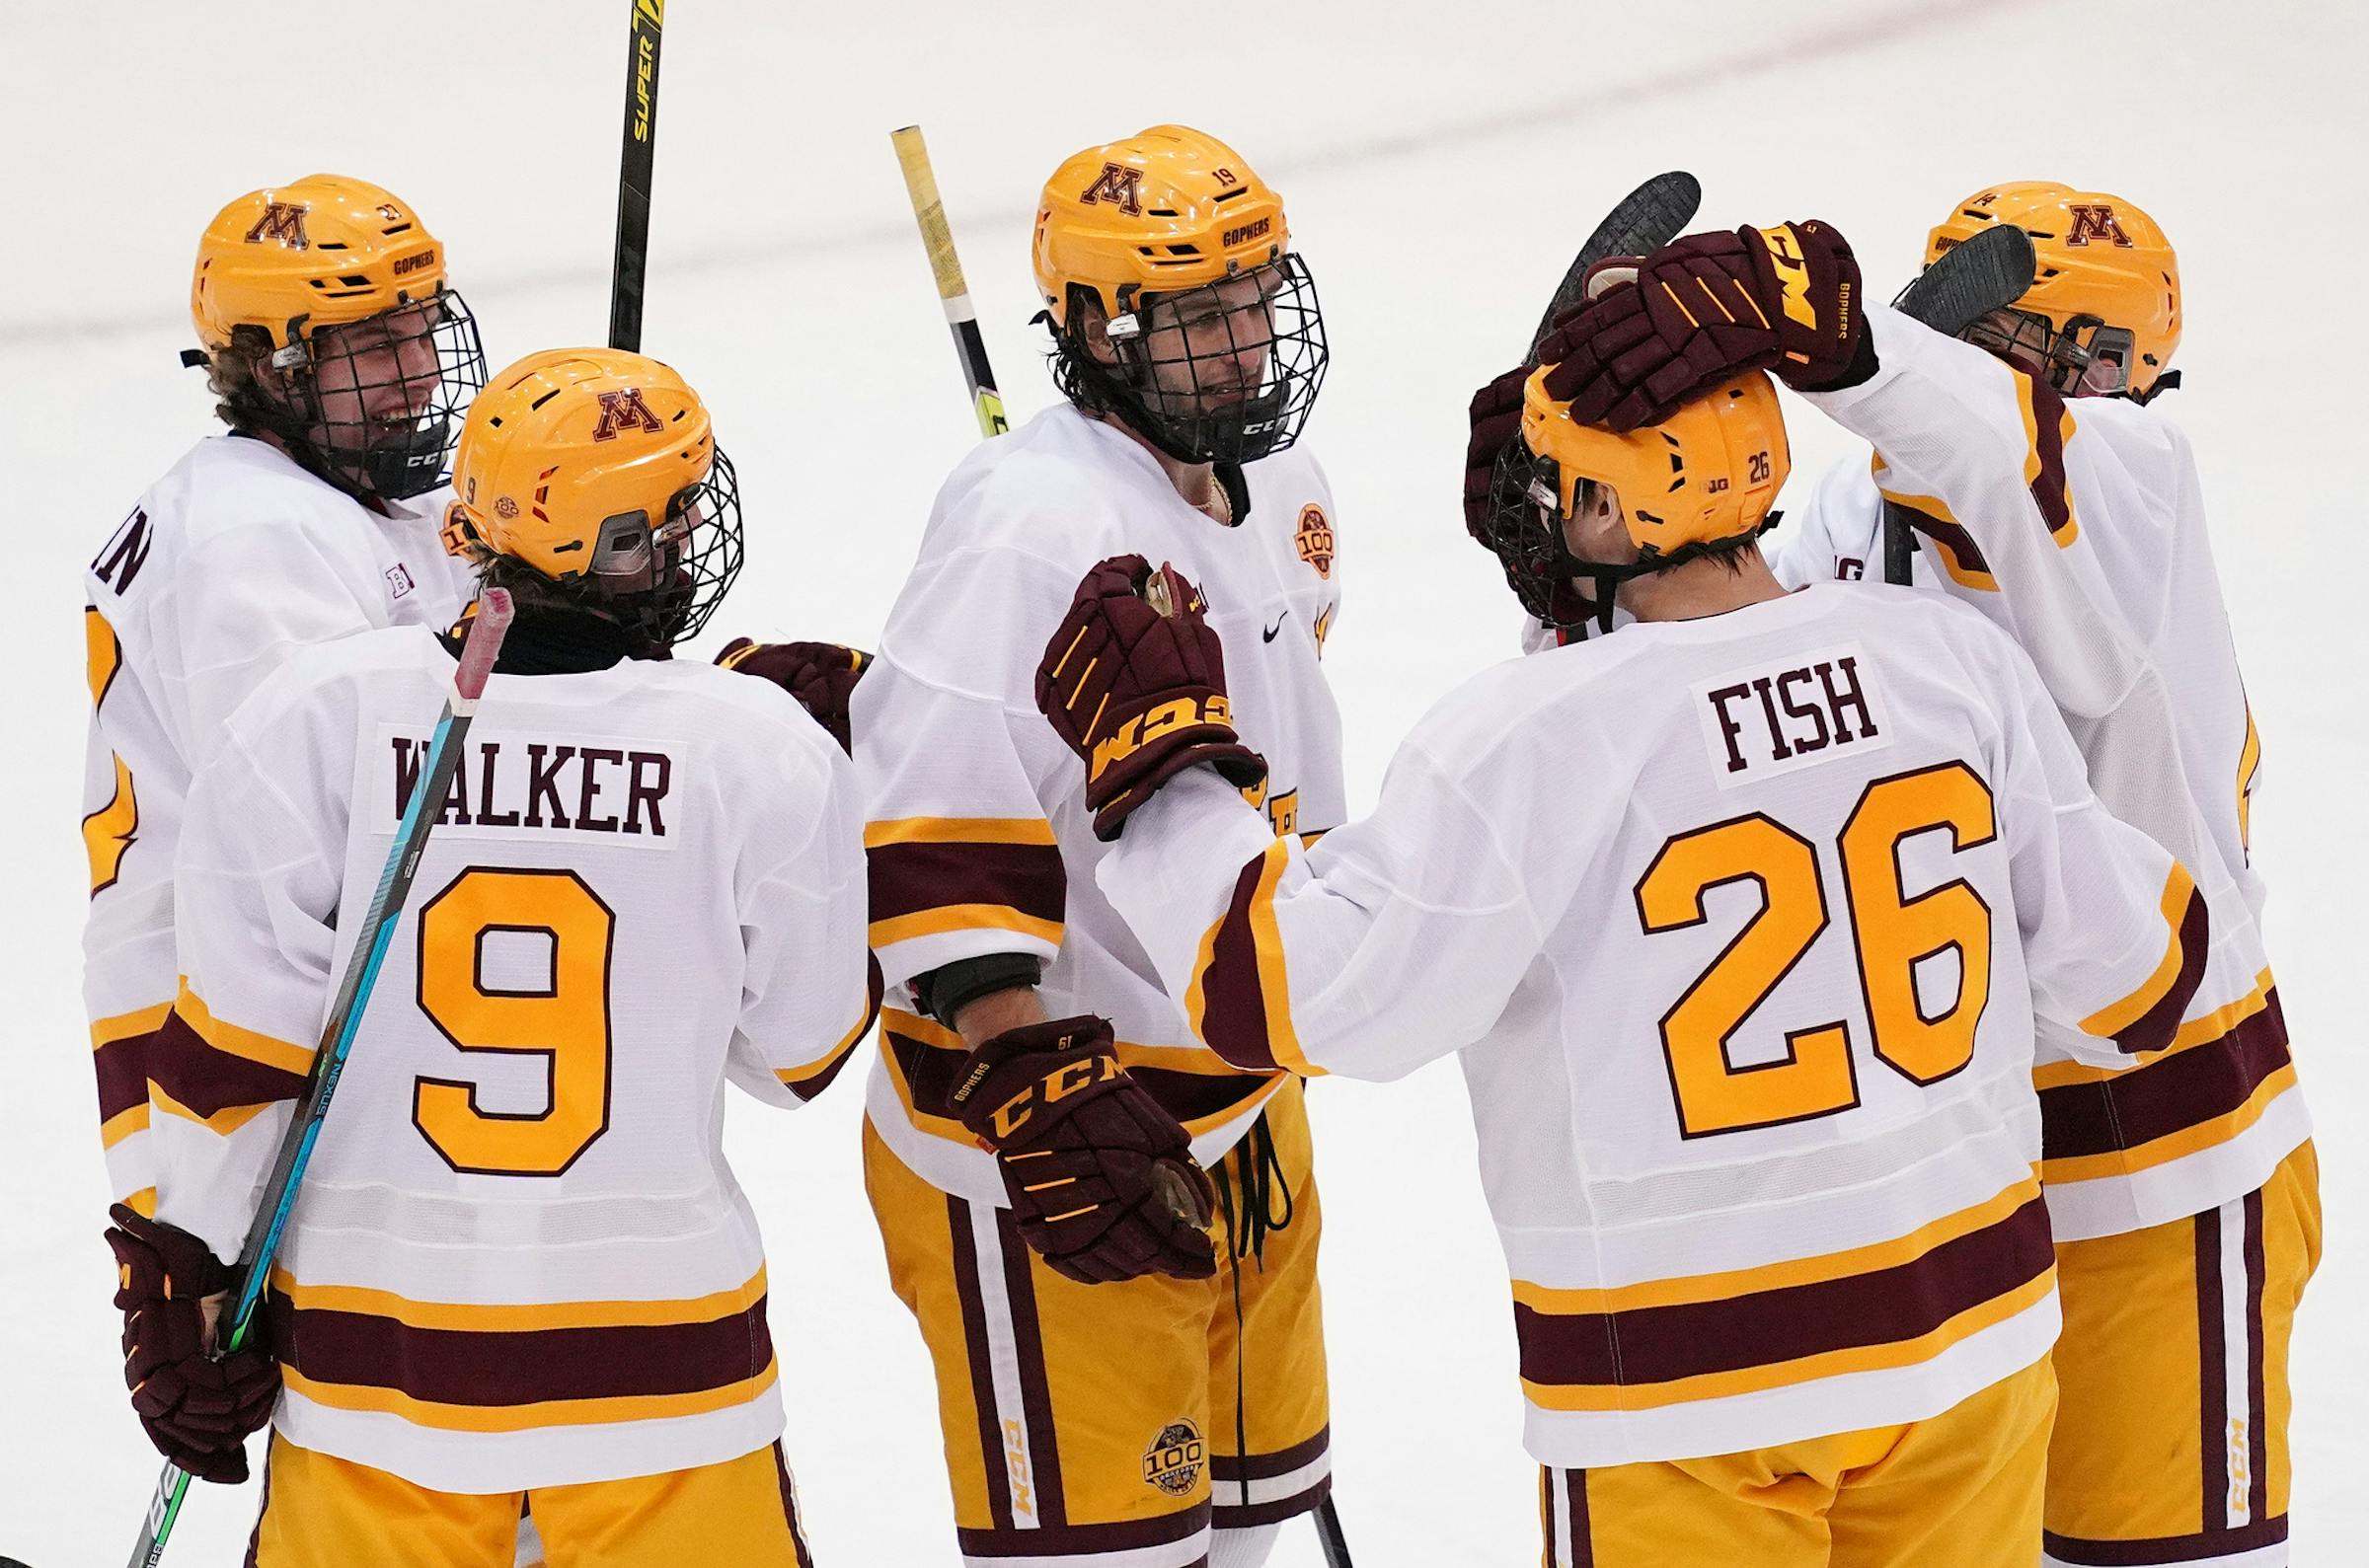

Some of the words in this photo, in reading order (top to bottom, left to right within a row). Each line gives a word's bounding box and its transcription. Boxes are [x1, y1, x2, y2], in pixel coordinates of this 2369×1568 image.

[634, 35, 653, 142] SUPER
[1080, 162, 1144, 217] M
[1211, 168, 1237, 187] 19
[245, 202, 311, 251] M
[1223, 218, 1270, 247] GOPHERS
[2066, 204, 2132, 248] M
[394, 250, 434, 275] GOPHERS
[593, 388, 664, 442] M
[467, 477, 476, 504] 9
[1748, 451, 1770, 484] 26
[1298, 532, 1333, 555] 100
[1708, 656, 1878, 773] FISH
[392, 737, 671, 836] WALKER
[1633, 759, 1997, 1141] 26
[412, 865, 616, 1177] 9
[316, 1063, 343, 1116] NEXUS
[954, 1062, 990, 1101] GOPHERS
[1005, 1419, 1032, 1517] CCM
[1146, 1442, 1201, 1476] 100
[2232, 1418, 2247, 1513] CCM
